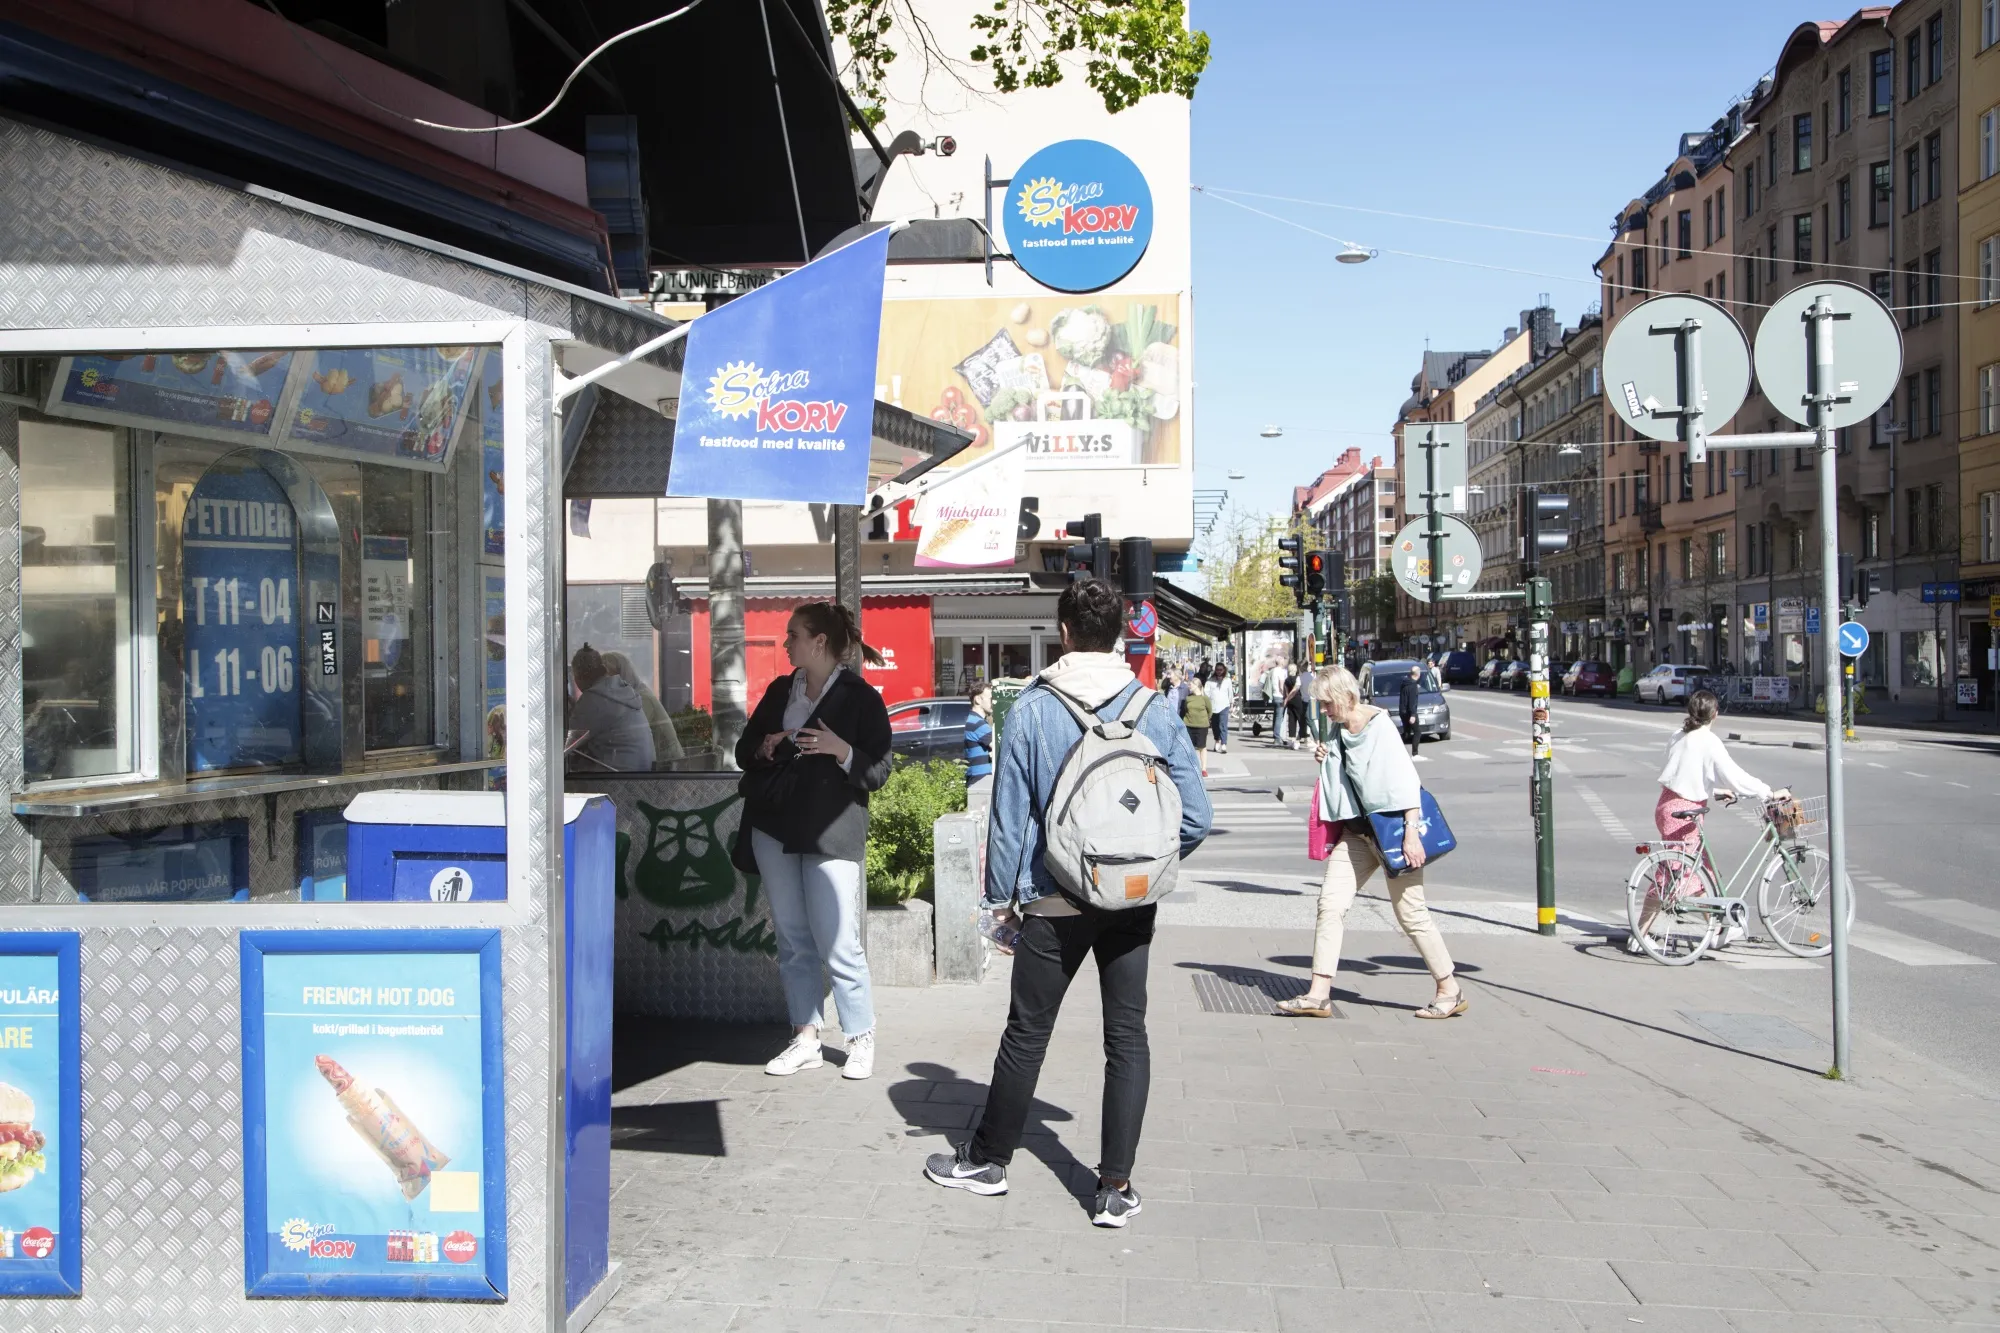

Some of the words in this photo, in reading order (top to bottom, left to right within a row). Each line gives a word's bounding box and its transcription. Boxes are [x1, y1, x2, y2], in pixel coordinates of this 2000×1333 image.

[1030, 182, 1104, 217] Solna
[1063, 204, 1139, 235] KORV
[1022, 237, 1068, 248] fastfood
[1071, 237, 1095, 246] med
[1098, 235, 1135, 246] kvalité
[669, 272, 768, 289] TUNNELBANA
[719, 370, 810, 406] Solna
[757, 398, 848, 433] KORV
[699, 435, 758, 449] fastfood
[762, 437, 794, 450] med
[797, 437, 846, 451] kvalité
[0, 987, 59, 1004] ULÄRA
[303, 986, 372, 1005] FRENCH
[377, 987, 412, 1006] HOT
[417, 988, 455, 1007] DOG
[312, 1024, 369, 1037] kokt/grillad
[378, 1024, 443, 1037] baguettebröd
[289, 1223, 335, 1244] Solna
[309, 1239, 356, 1258] KORV
